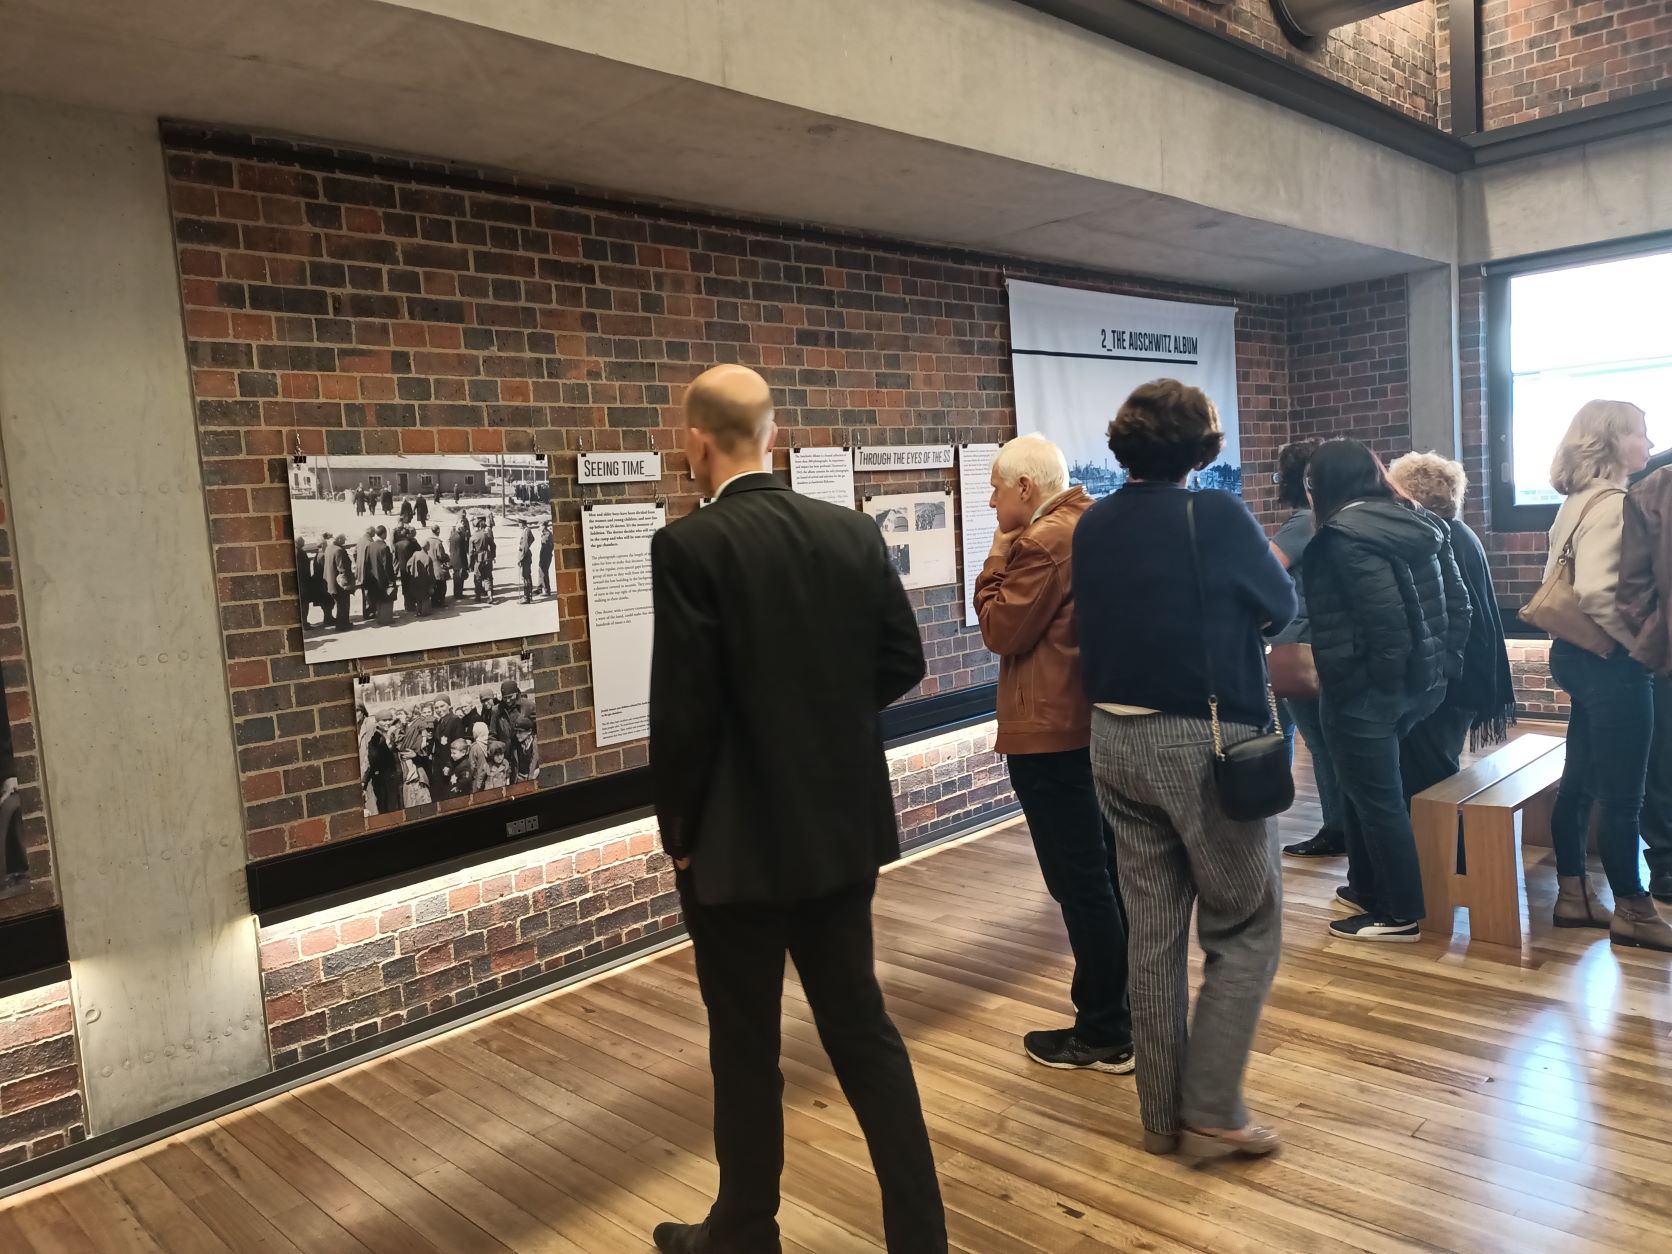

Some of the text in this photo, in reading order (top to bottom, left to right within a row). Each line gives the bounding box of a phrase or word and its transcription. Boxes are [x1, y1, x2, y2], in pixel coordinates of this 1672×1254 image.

[1128, 331, 1172, 353] AUSCHWITZ
[1173, 335, 1198, 355] ALBUM
[859, 451, 891, 466] THROUGH
[893, 452, 905, 464] THE
[906, 451, 922, 464] EYES
[923, 451, 931, 464] OF
[932, 451, 942, 463] THE
[943, 449, 951, 462] SS
[584, 459, 619, 477] SEEING
